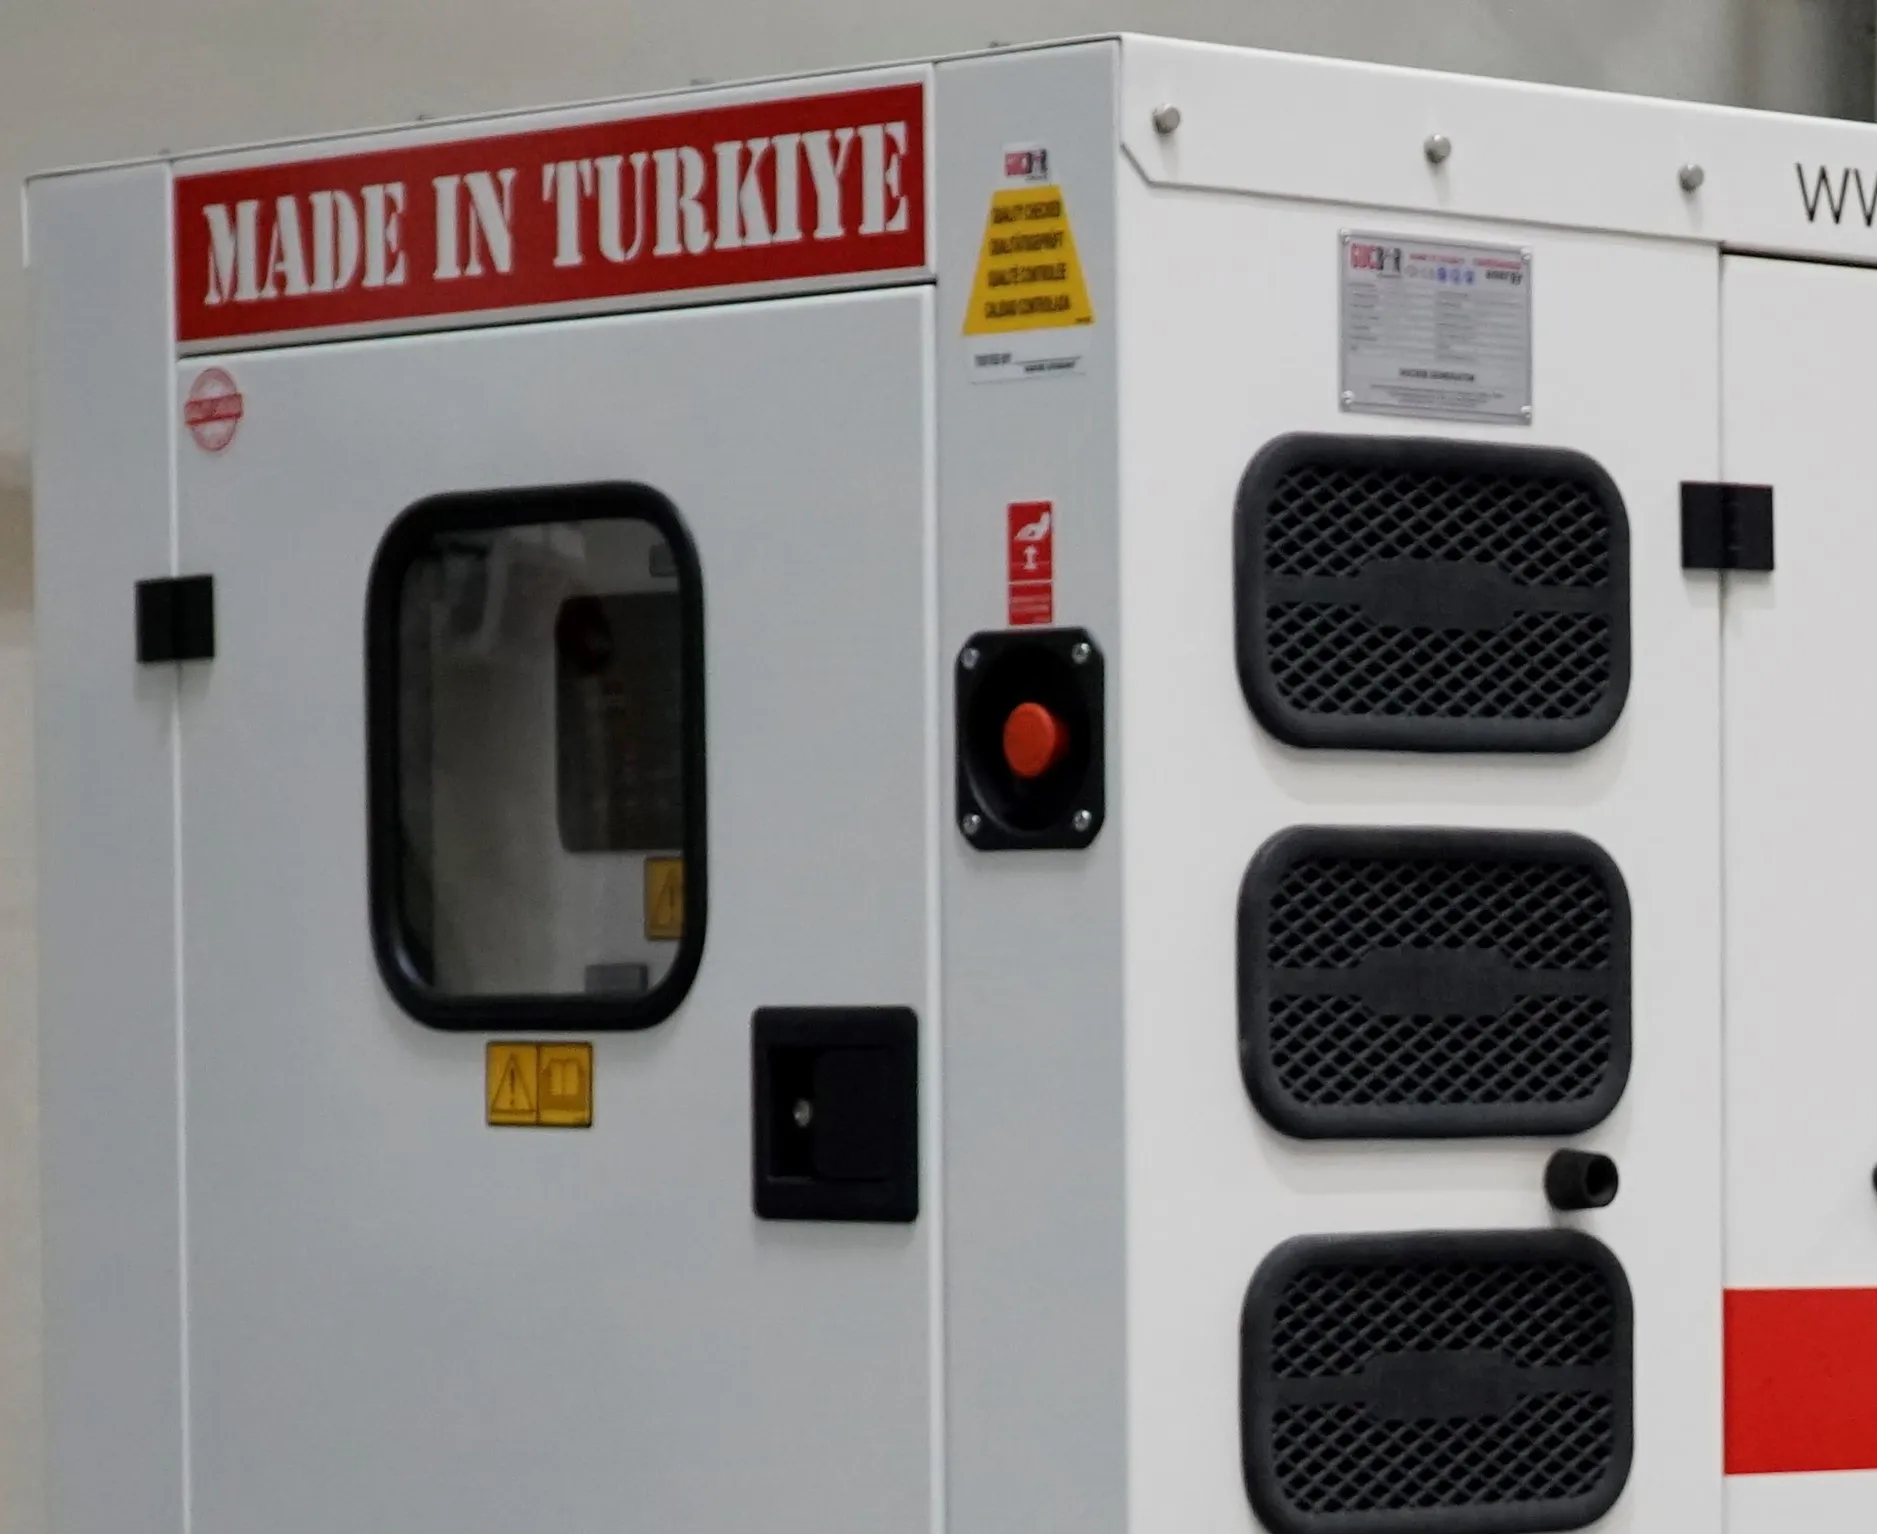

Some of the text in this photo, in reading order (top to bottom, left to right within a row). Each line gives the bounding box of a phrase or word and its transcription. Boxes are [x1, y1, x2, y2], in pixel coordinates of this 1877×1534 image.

[203, 121, 909, 305] MADE IN TURKIYE
